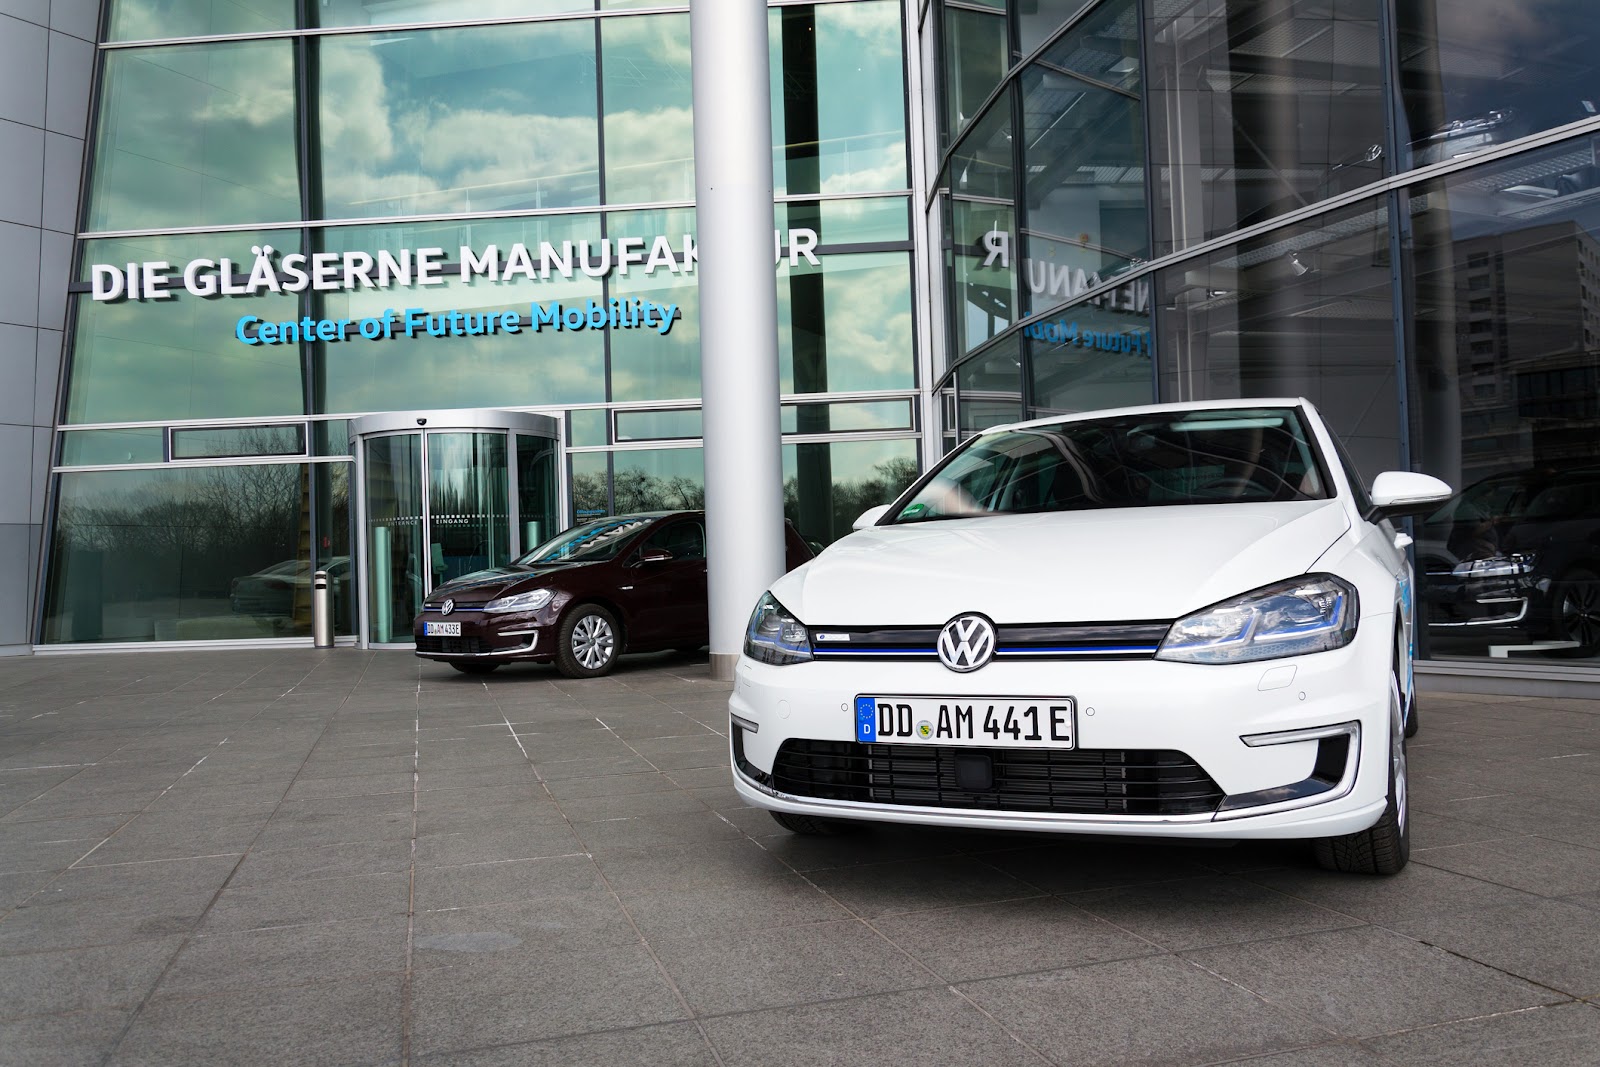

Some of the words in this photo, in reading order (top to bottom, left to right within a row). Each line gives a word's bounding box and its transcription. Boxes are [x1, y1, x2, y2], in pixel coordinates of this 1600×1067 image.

[91, 262, 171, 300] DIE
[183, 244, 444, 297] GLÄSERNE
[236, 315, 351, 345] Center
[359, 308, 396, 339] of
[404, 302, 521, 337] Future
[531, 296, 678, 334] Mobility
[863, 723, 871, 734] D
[877, 703, 913, 737] DD
[936, 704, 974, 740] AM
